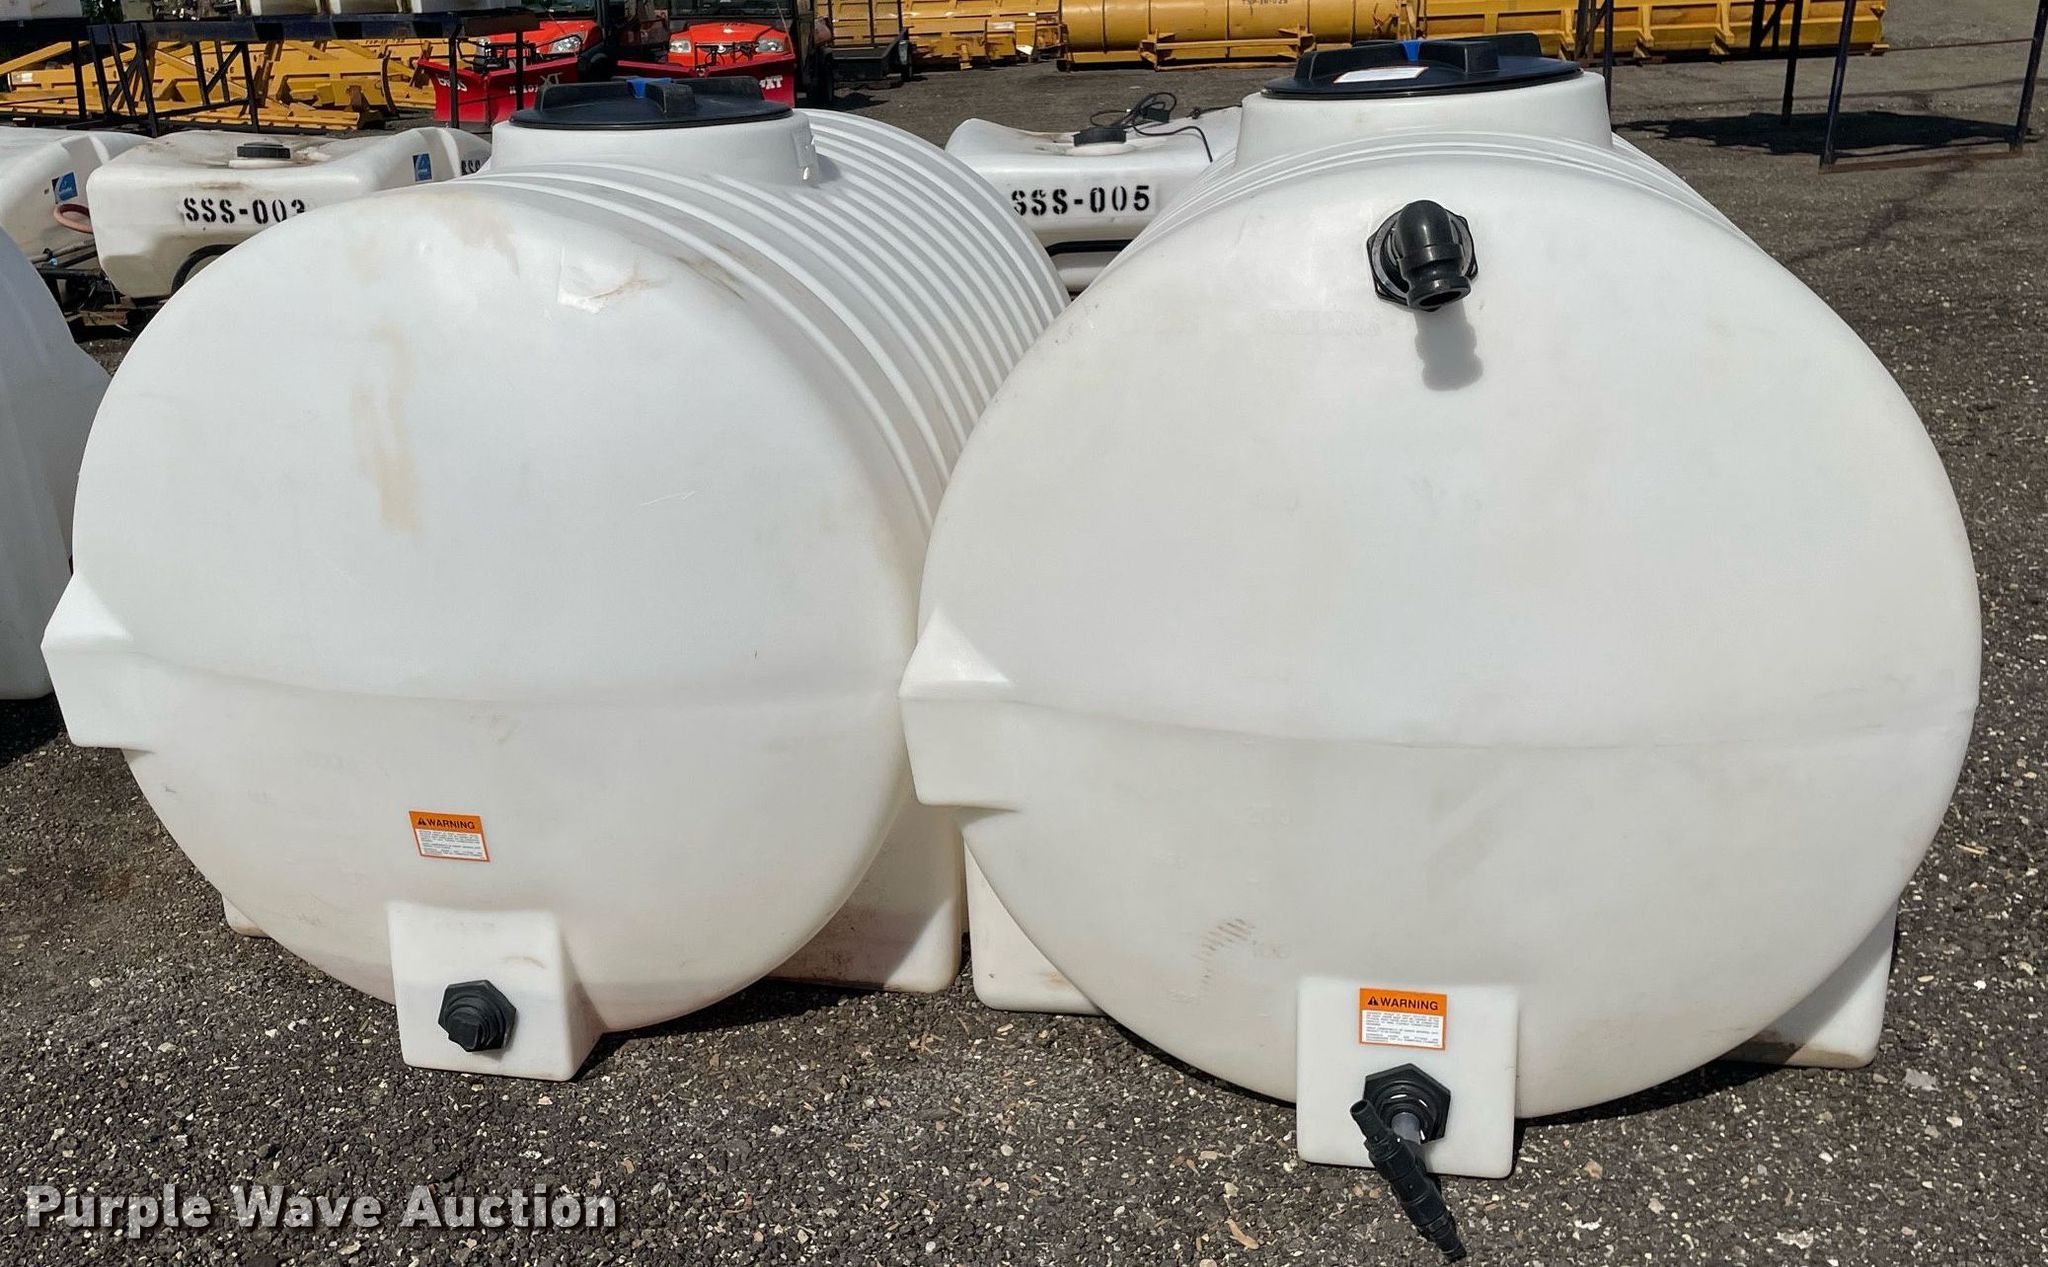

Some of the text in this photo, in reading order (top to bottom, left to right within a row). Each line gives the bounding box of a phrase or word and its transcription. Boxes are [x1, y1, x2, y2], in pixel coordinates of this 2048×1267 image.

[1011, 184, 1150, 217] SSS-005
[426, 818, 475, 830] WARNING
[1380, 997, 1438, 1010] WARNING
